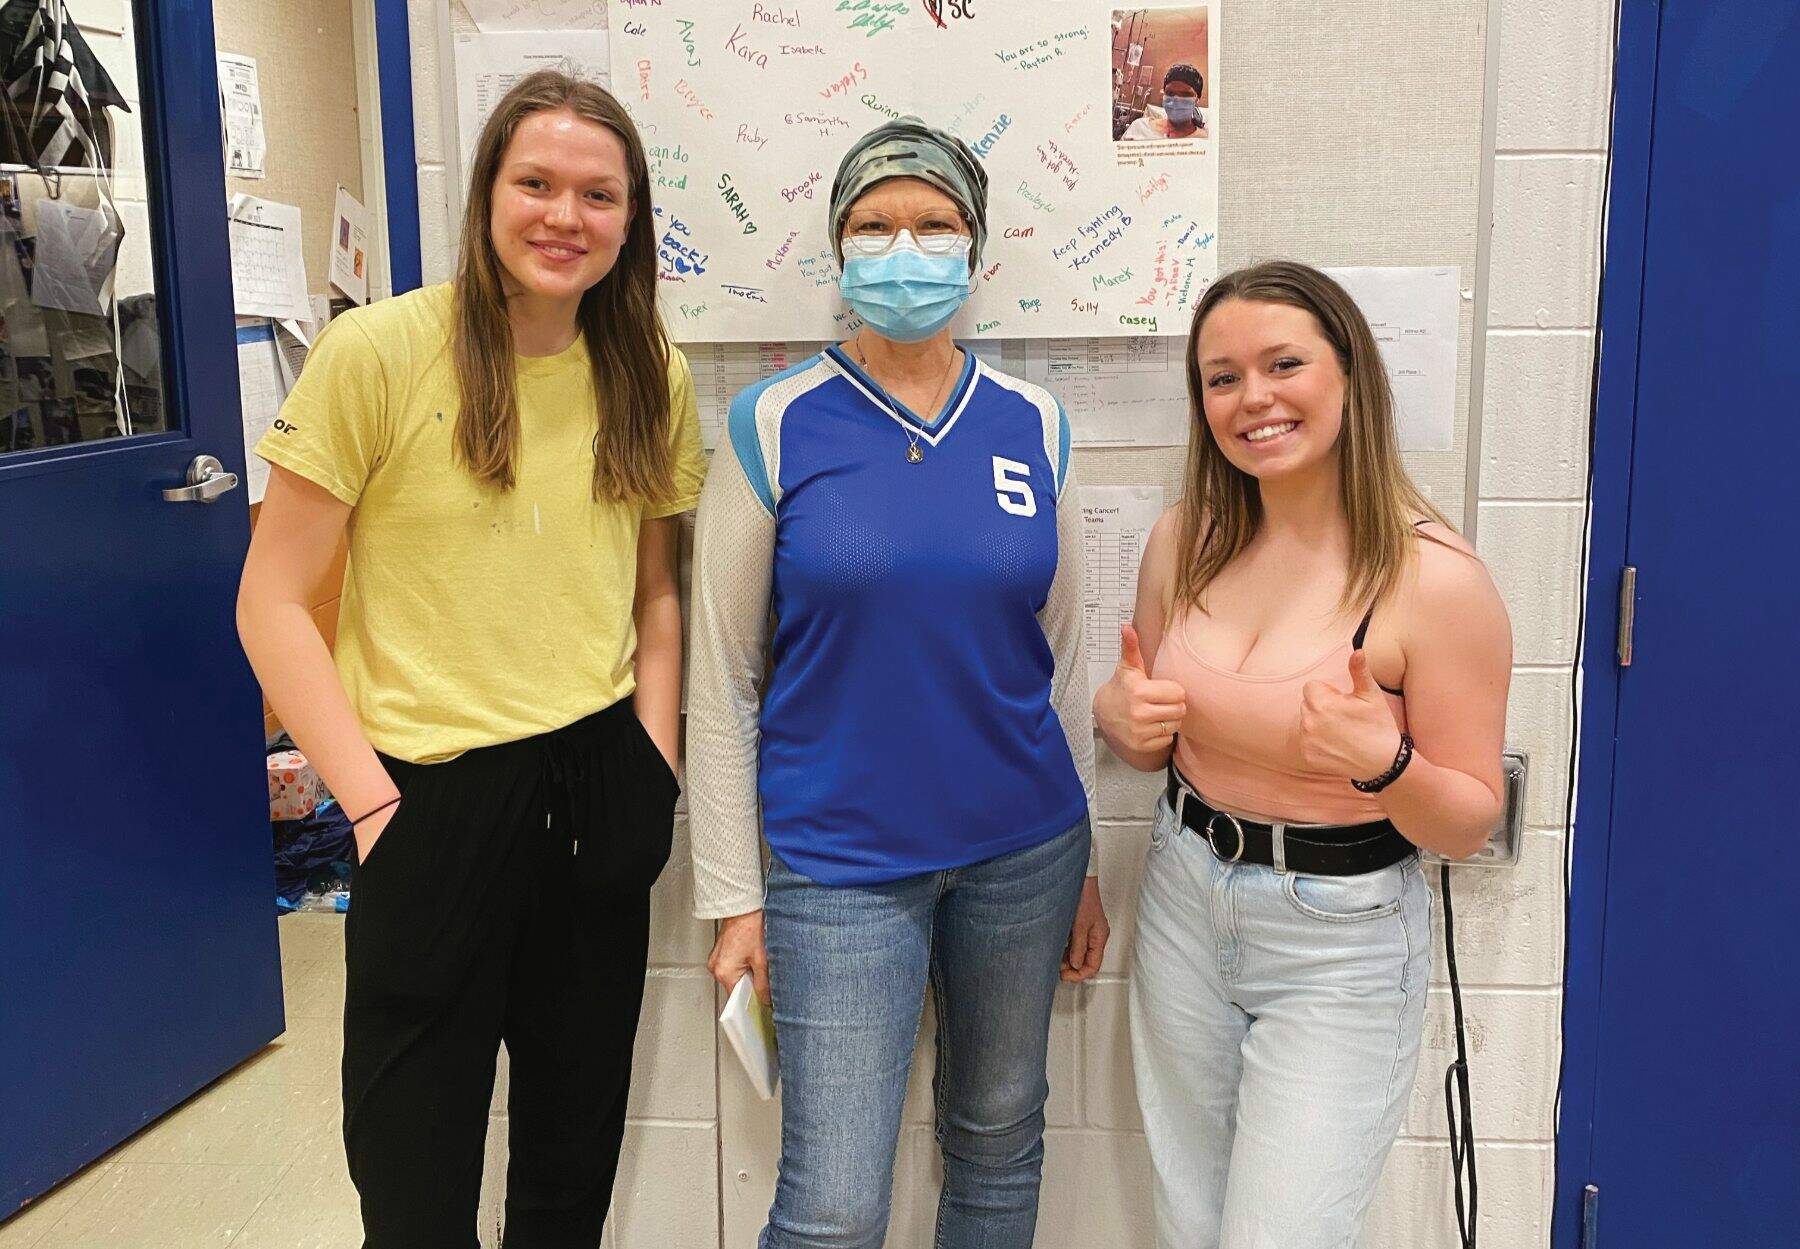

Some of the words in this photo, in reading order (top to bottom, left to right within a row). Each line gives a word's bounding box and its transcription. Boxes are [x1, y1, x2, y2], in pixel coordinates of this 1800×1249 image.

[623, 21, 647, 37] Cole
[752, 3, 801, 28] Rachel
[725, 23, 768, 70] Kara
[778, 44, 826, 56] Isabelle
[1019, 45, 1034, 56] are
[1037, 39, 1049, 48] so
[1054, 25, 1089, 41] strong!
[736, 124, 768, 150] Ruby
[970, 112, 1012, 159] Kenzie
[718, 173, 749, 222] SARAH
[781, 172, 823, 203] Brooke
[1052, 238, 1077, 260] Keep
[1077, 205, 1124, 239] fighting
[680, 301, 709, 320] Piper
[1071, 299, 1099, 315] Sully
[992, 456, 1037, 517] 5
